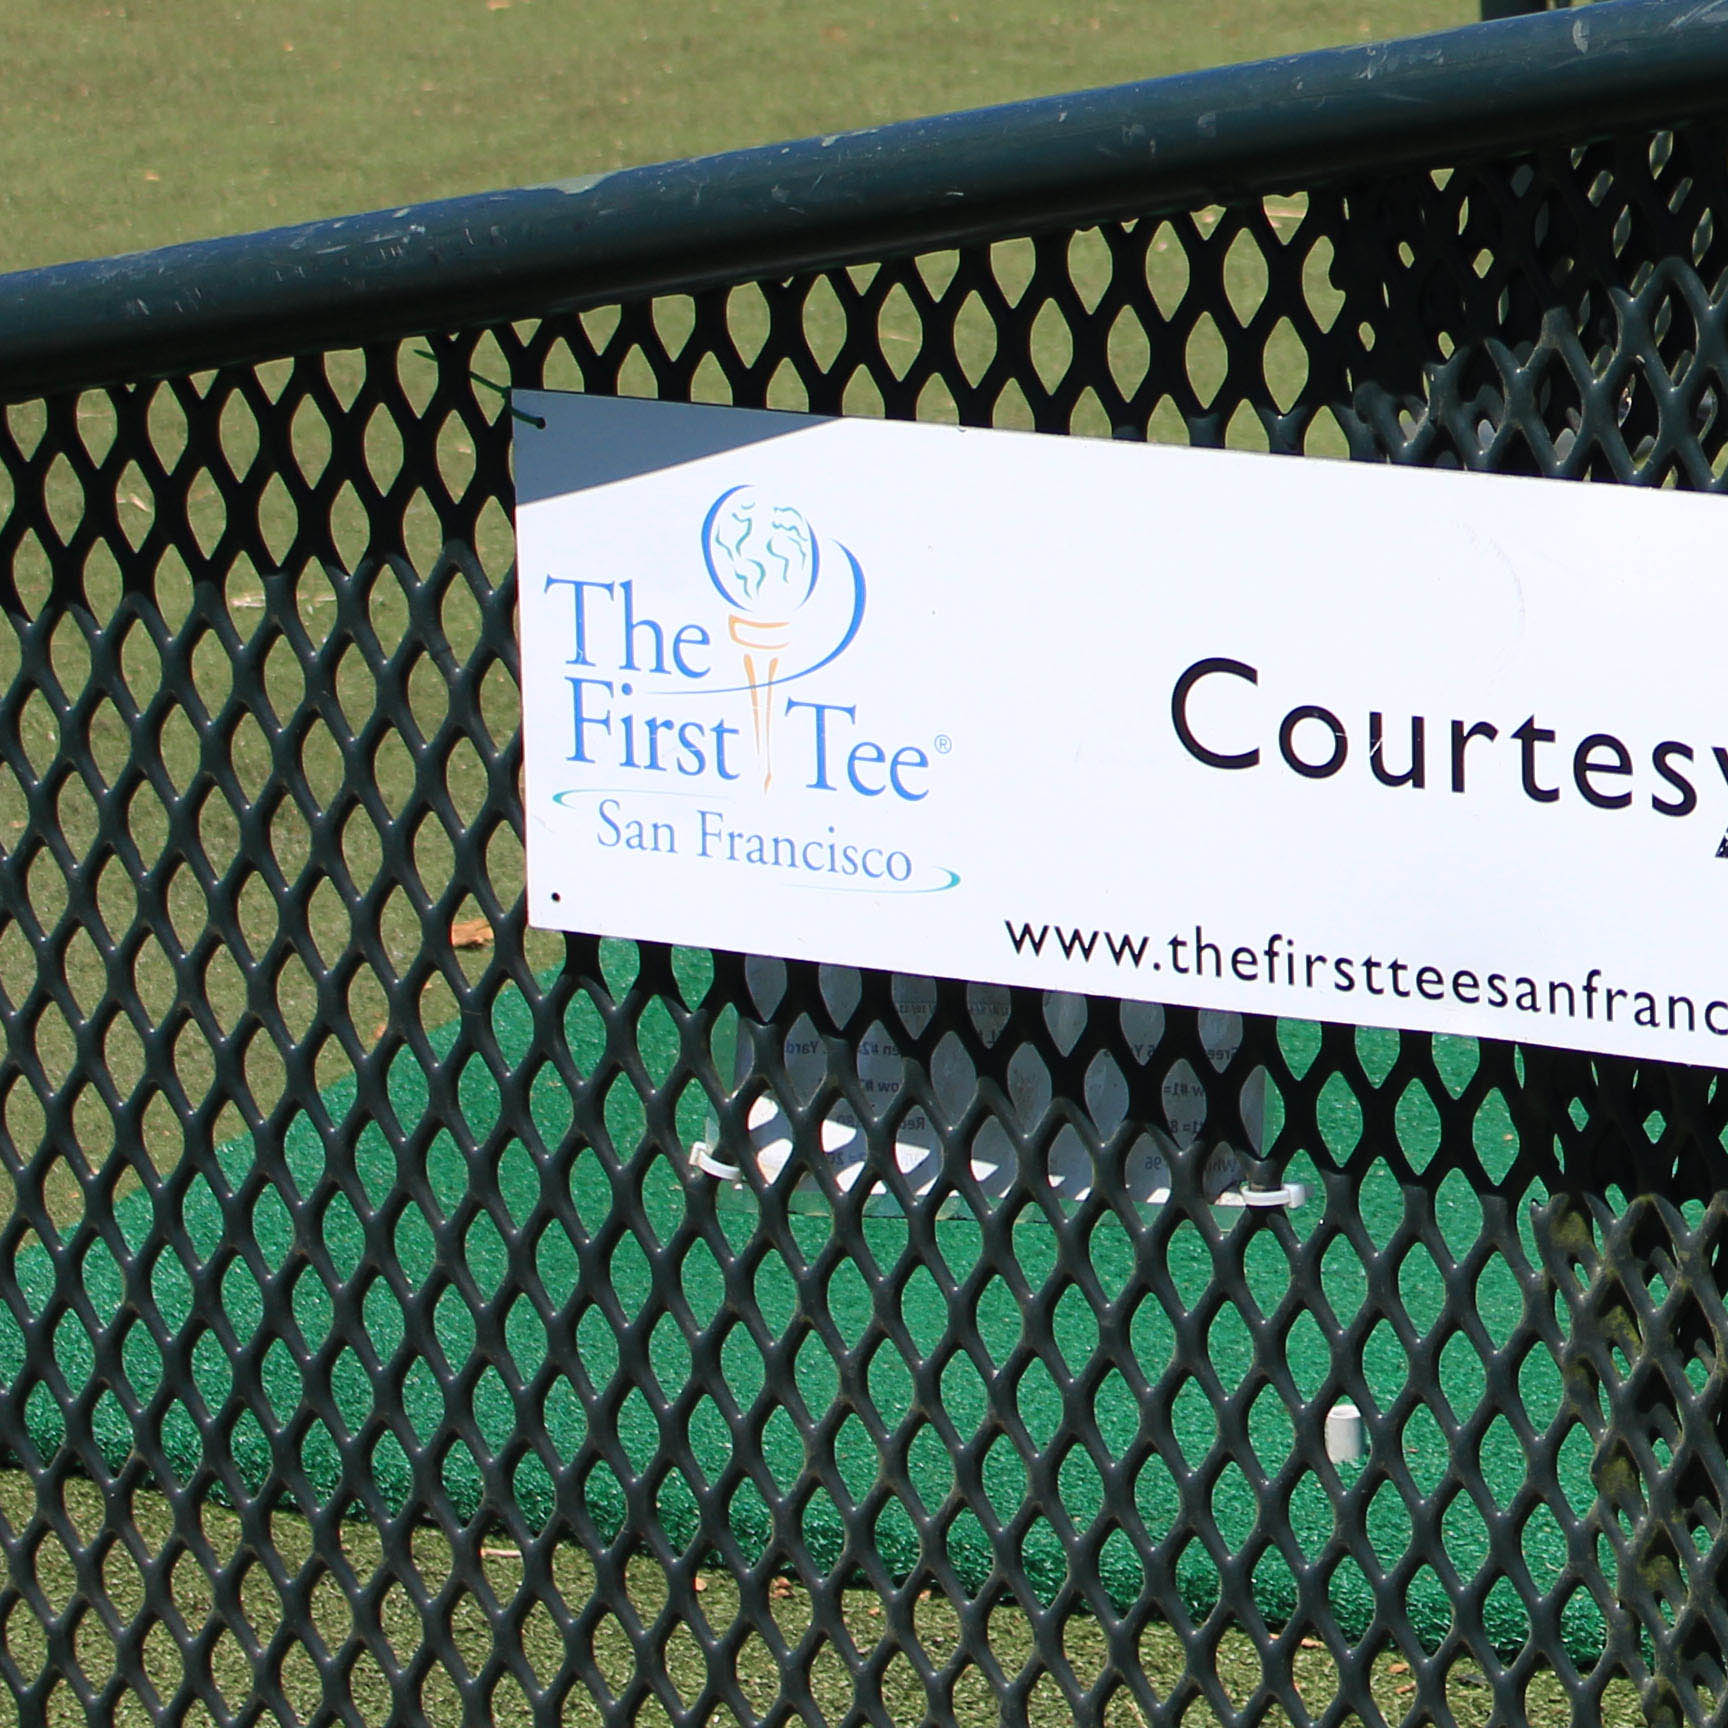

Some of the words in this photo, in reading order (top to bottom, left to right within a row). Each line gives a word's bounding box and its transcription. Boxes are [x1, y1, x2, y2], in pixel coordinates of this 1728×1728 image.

[543, 573, 712, 680] The
[564, 675, 741, 781] First
[596, 798, 679, 855] San
[696, 809, 913, 882] Francisco
